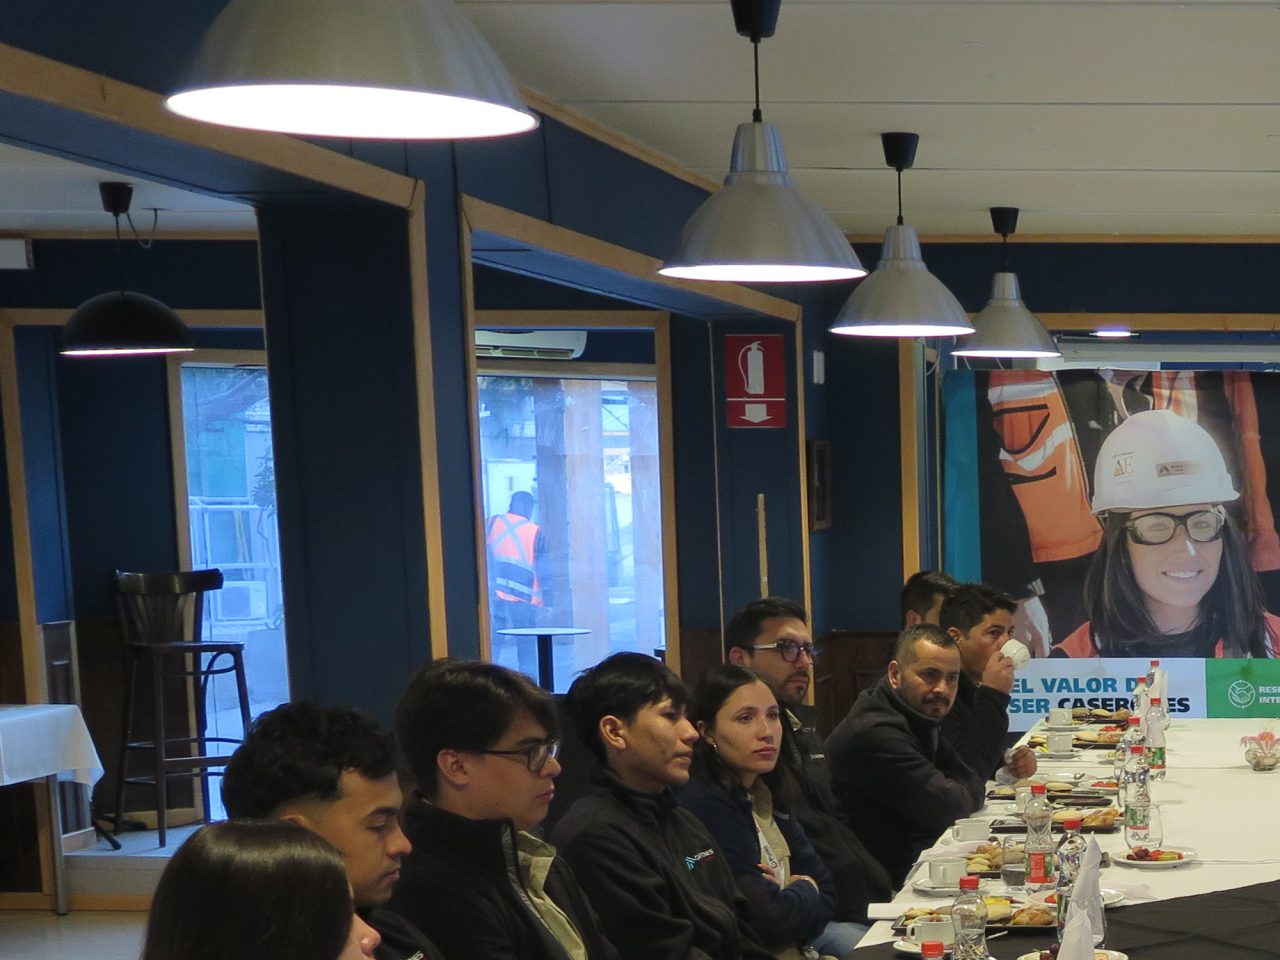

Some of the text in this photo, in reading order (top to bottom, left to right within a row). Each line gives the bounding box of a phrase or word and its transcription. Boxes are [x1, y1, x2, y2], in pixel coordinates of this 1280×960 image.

[1011, 678, 1034, 693] EL
[1041, 677, 1117, 693] VALOR
[1009, 697, 1191, 713] SER CASERES
